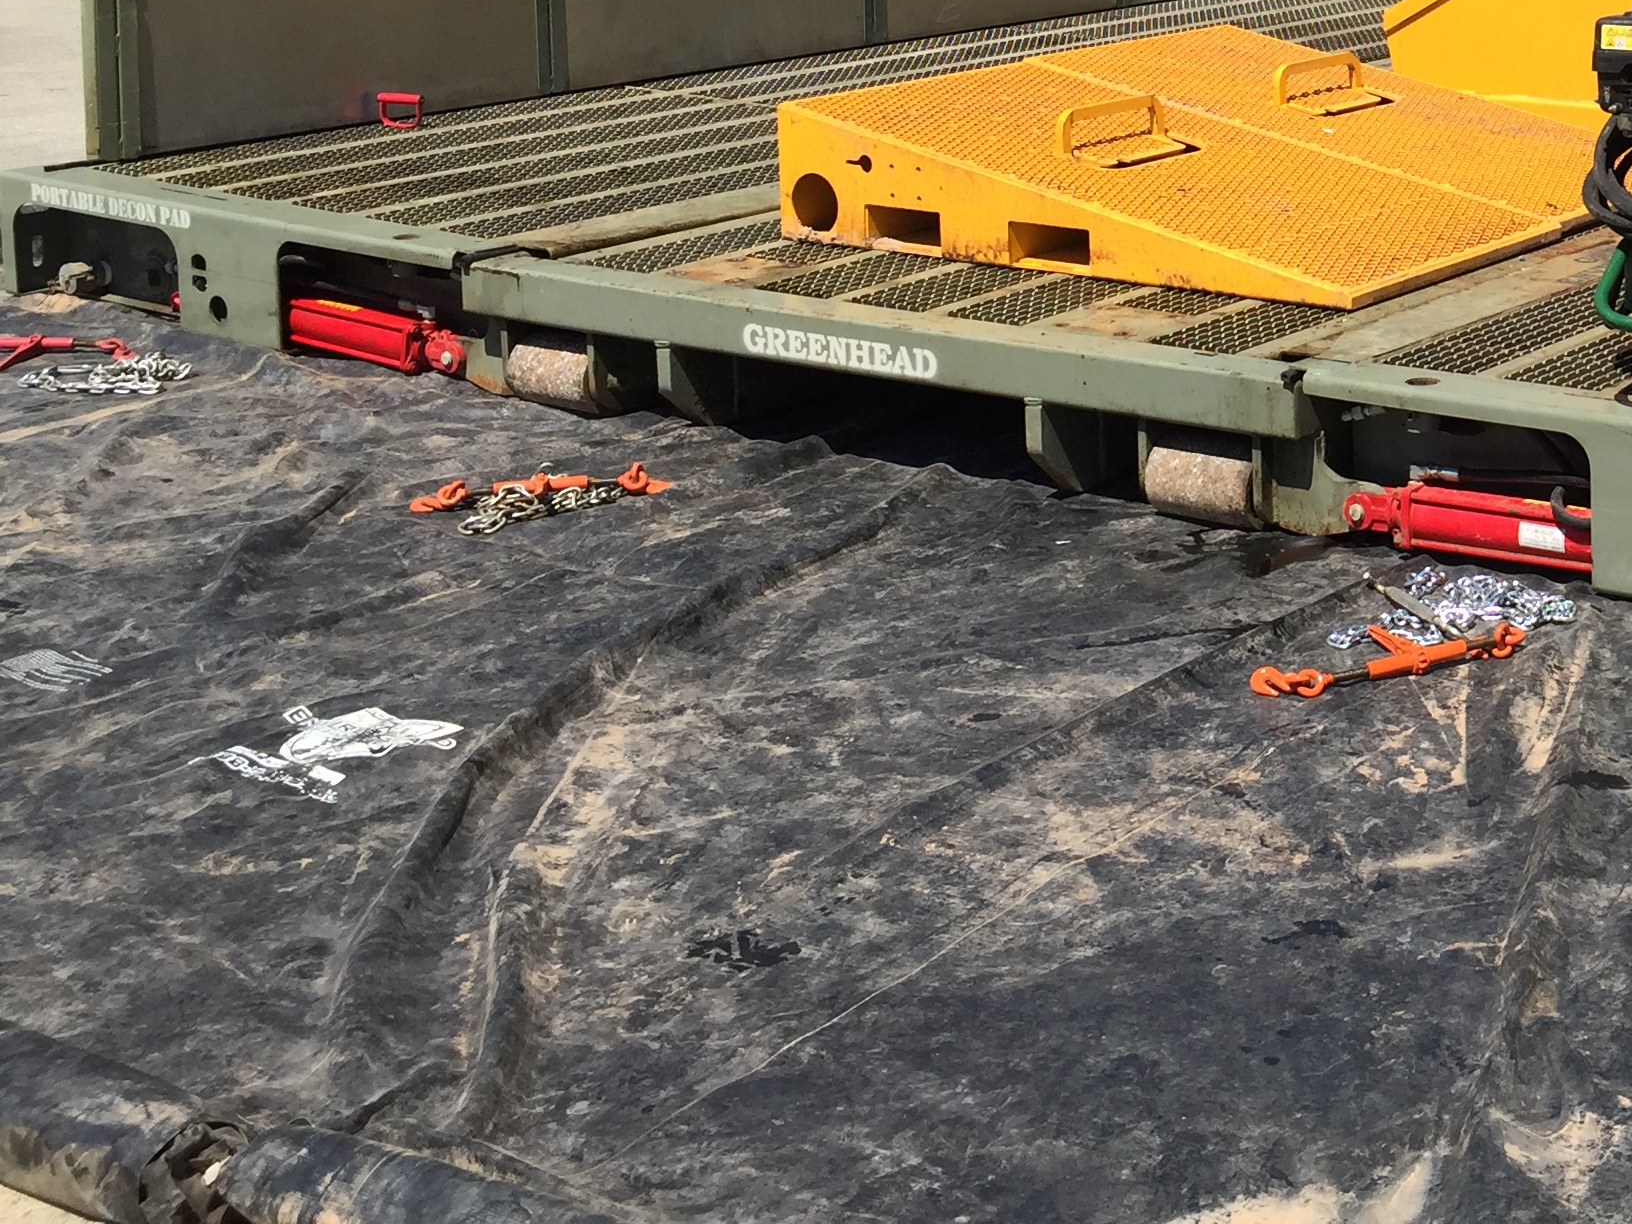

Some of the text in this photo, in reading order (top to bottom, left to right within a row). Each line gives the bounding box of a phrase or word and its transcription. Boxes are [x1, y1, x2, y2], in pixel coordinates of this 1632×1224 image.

[30, 183, 191, 229] PORTABLE DECON PAD
[742, 323, 938, 379] GREENHEAD
